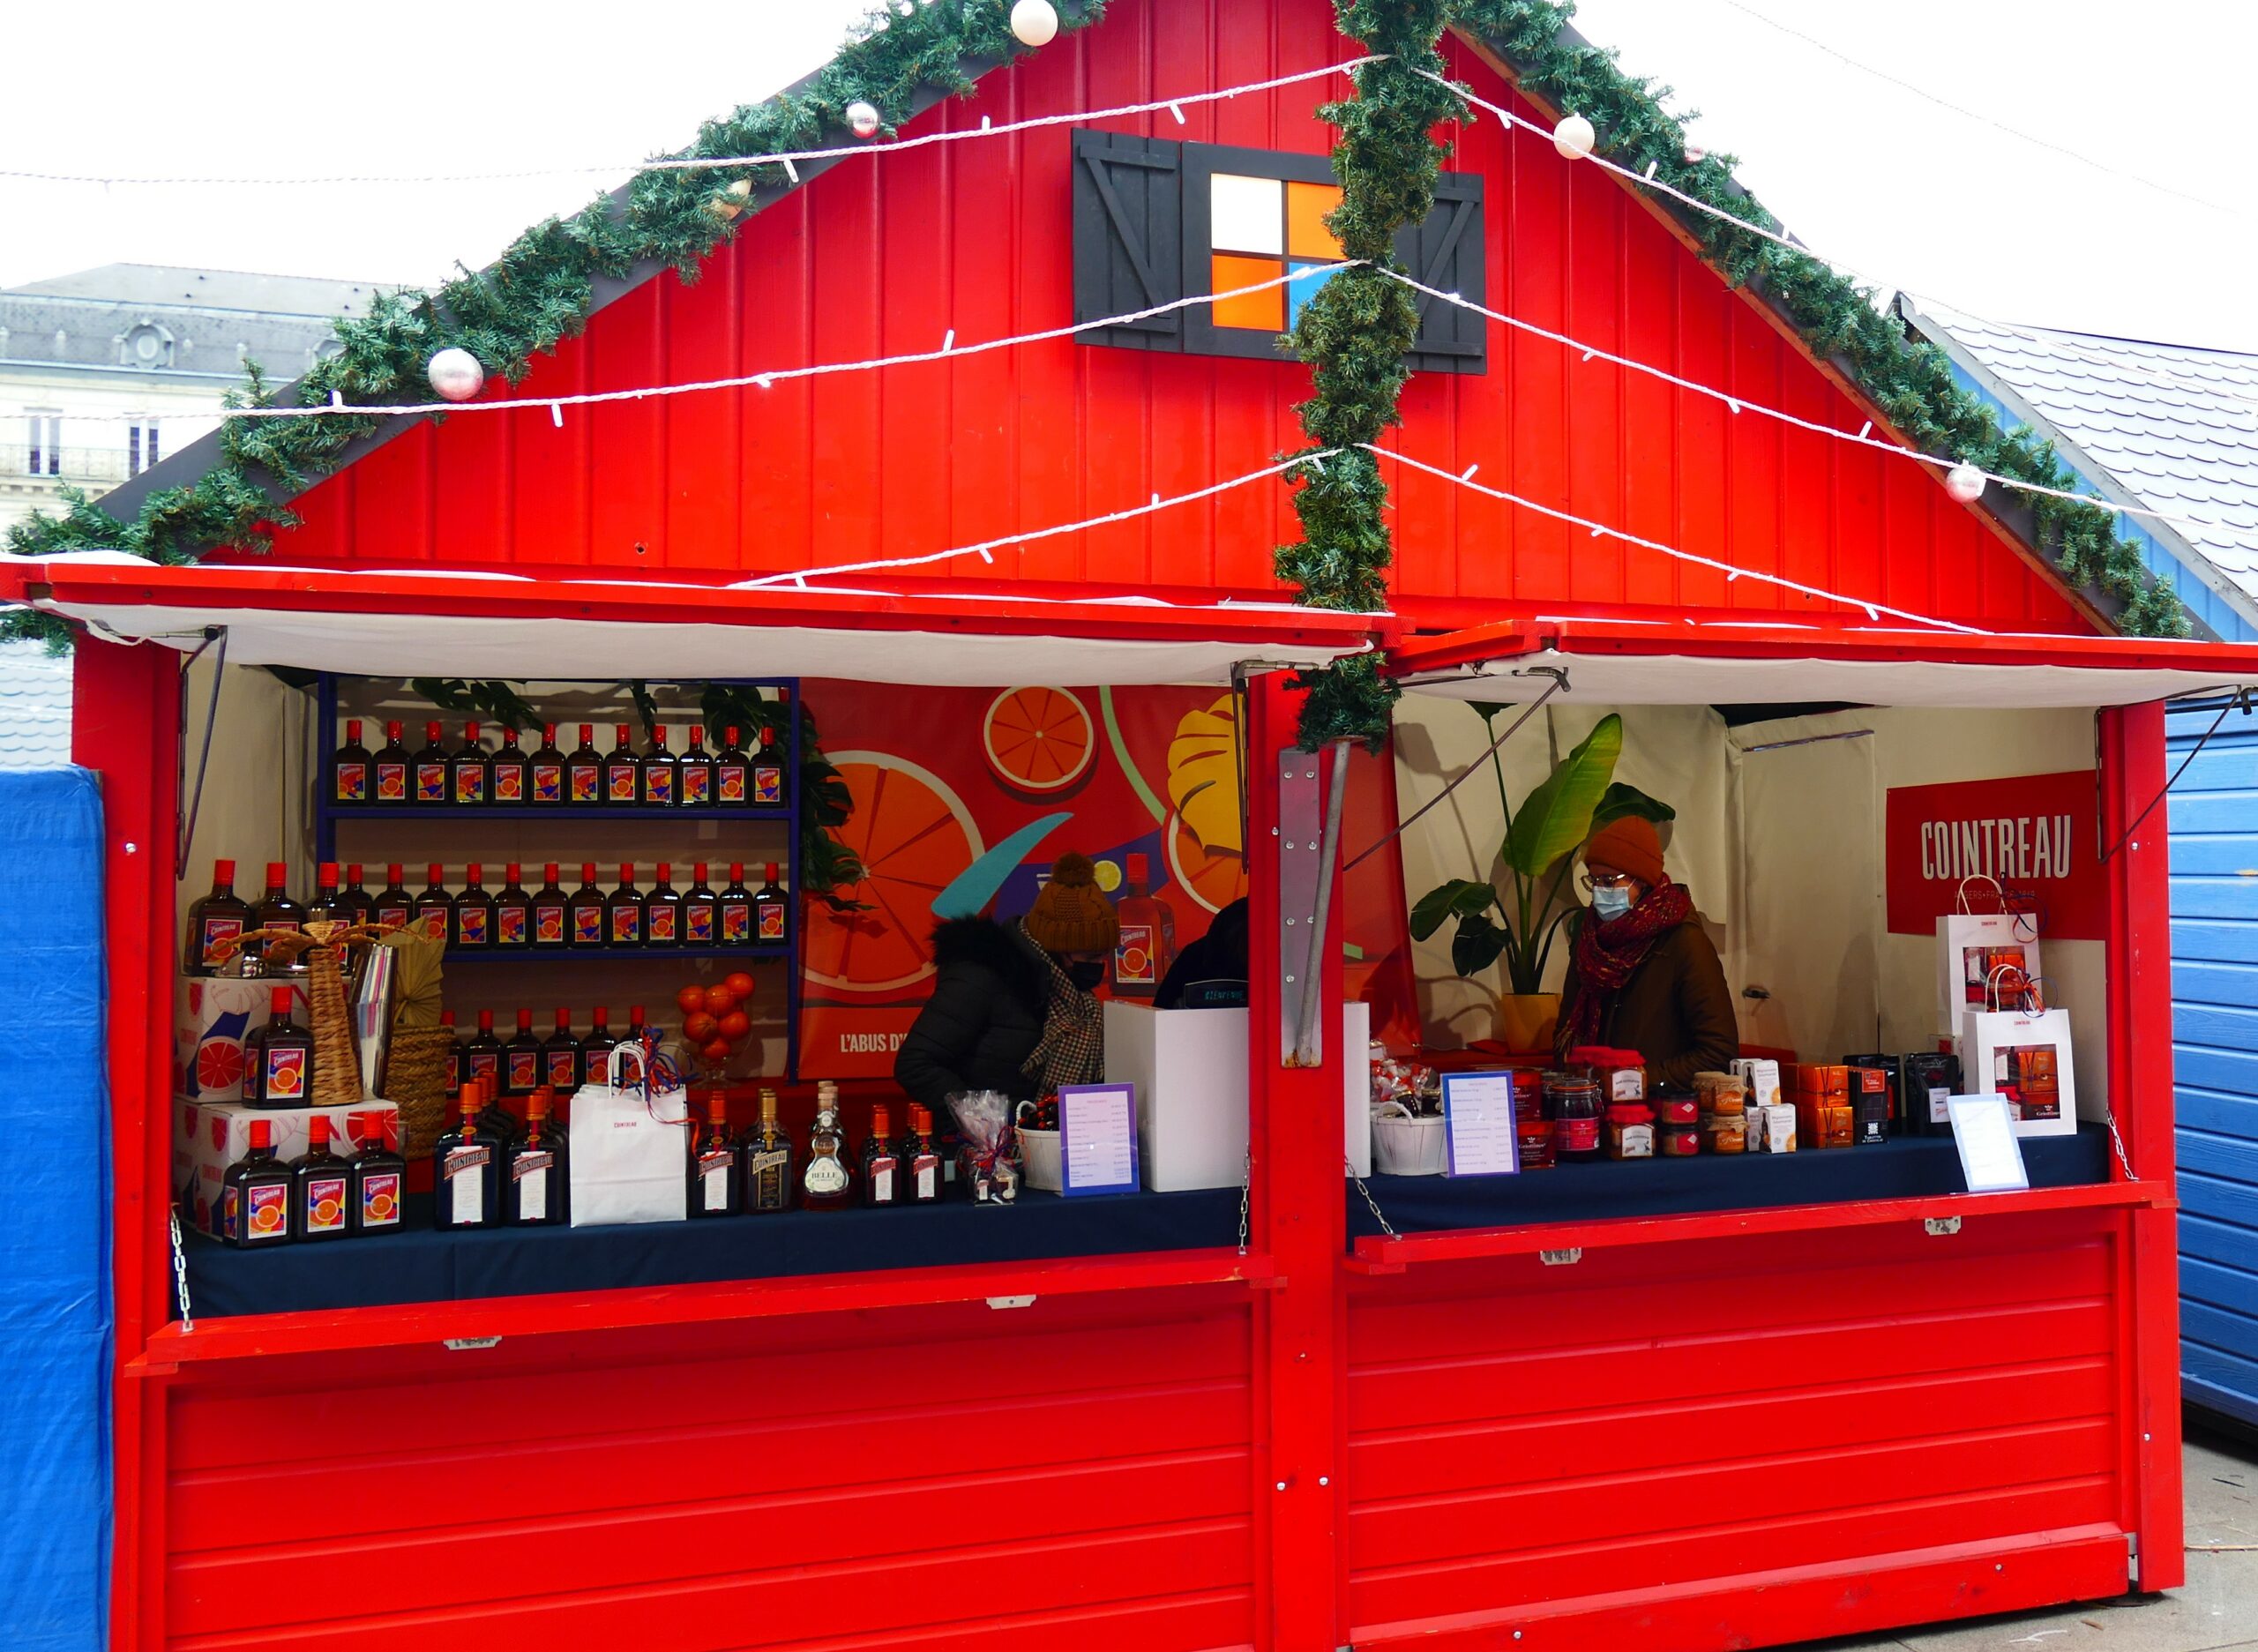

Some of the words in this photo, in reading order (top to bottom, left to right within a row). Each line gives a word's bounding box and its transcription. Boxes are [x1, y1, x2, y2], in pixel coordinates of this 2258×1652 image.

[1921, 815, 2071, 879] COINTREAU
[841, 1034, 887, 1053] L'ABUS
[889, 1033, 908, 1051] D'
[447, 1150, 490, 1174] COINTREAU
[516, 1155, 552, 1175] COINTREAU
[755, 1153, 786, 1170] COINTREAU
